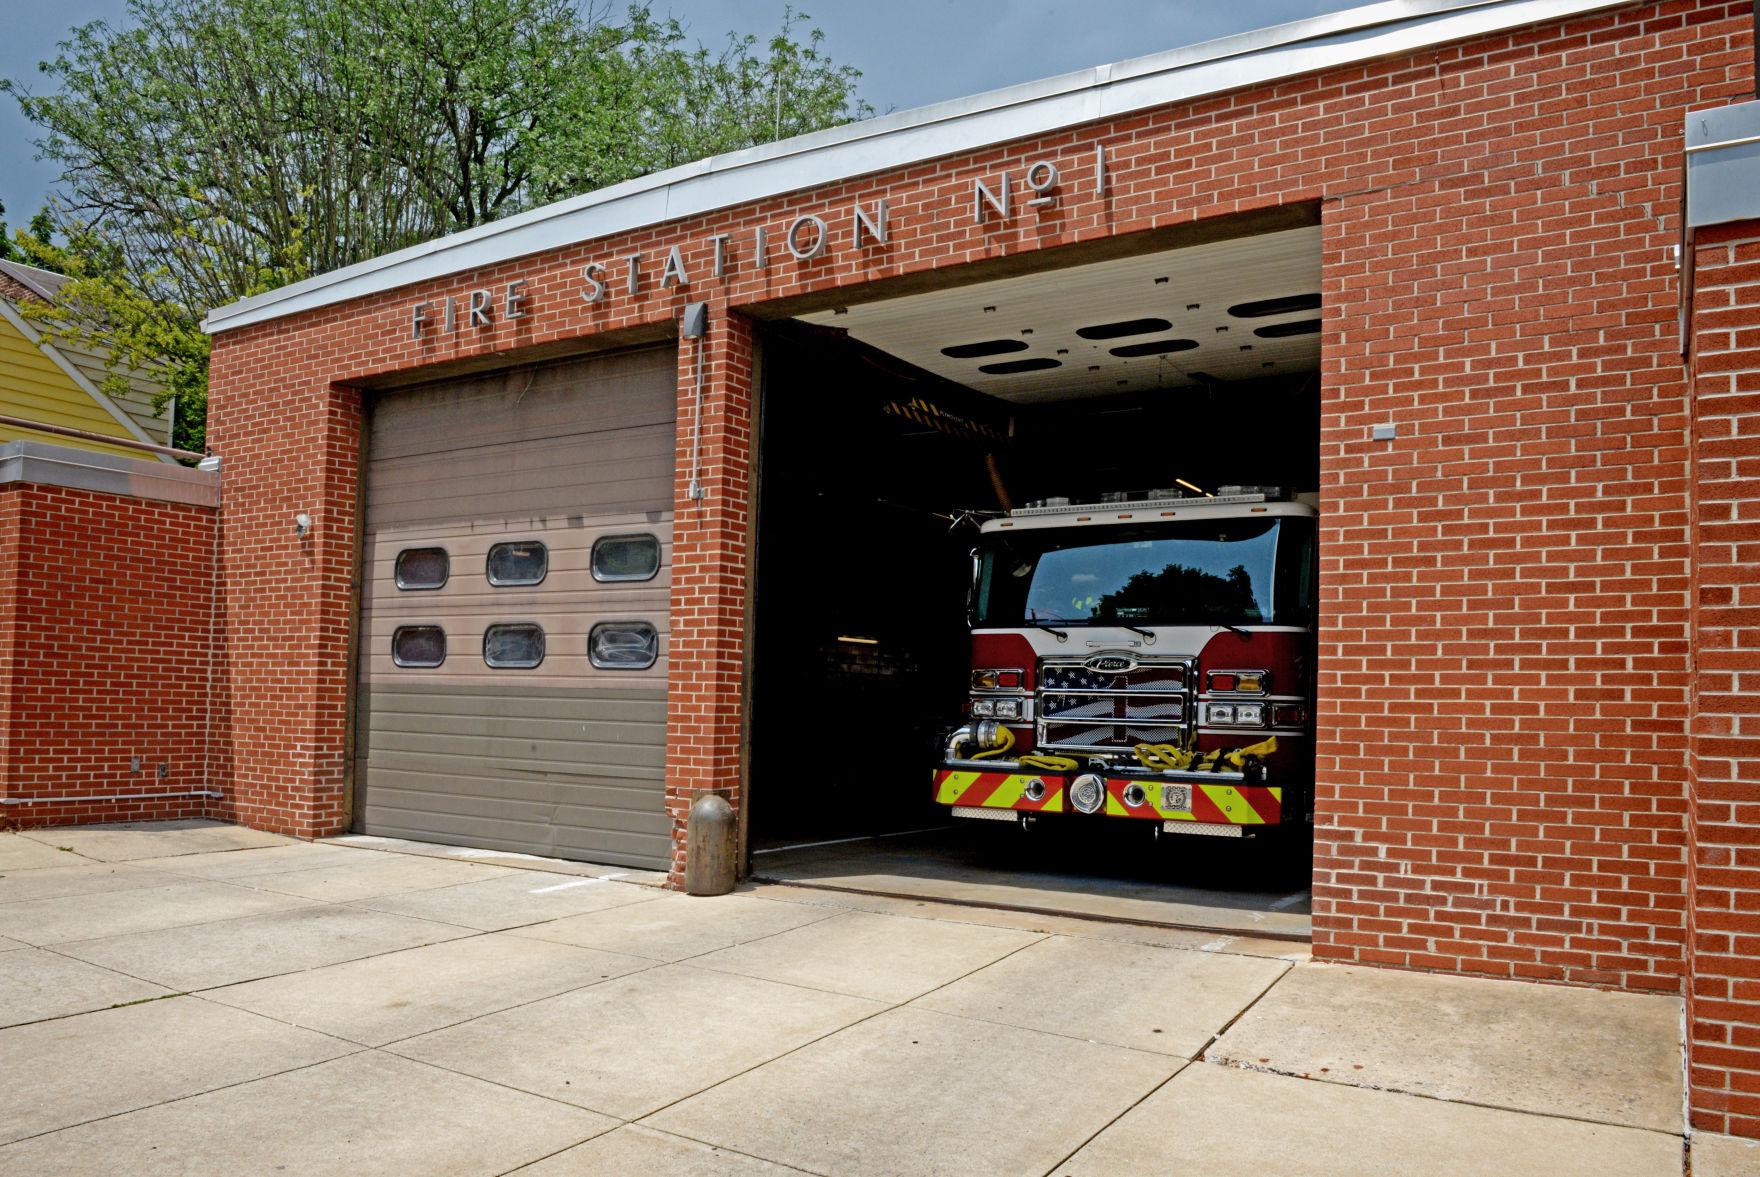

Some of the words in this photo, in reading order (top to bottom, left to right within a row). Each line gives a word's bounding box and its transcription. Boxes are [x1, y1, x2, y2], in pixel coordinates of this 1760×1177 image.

[412, 279, 528, 339] FIRE
[581, 199, 888, 303] STATION
[1096, 658, 1126, 669] Pierce
